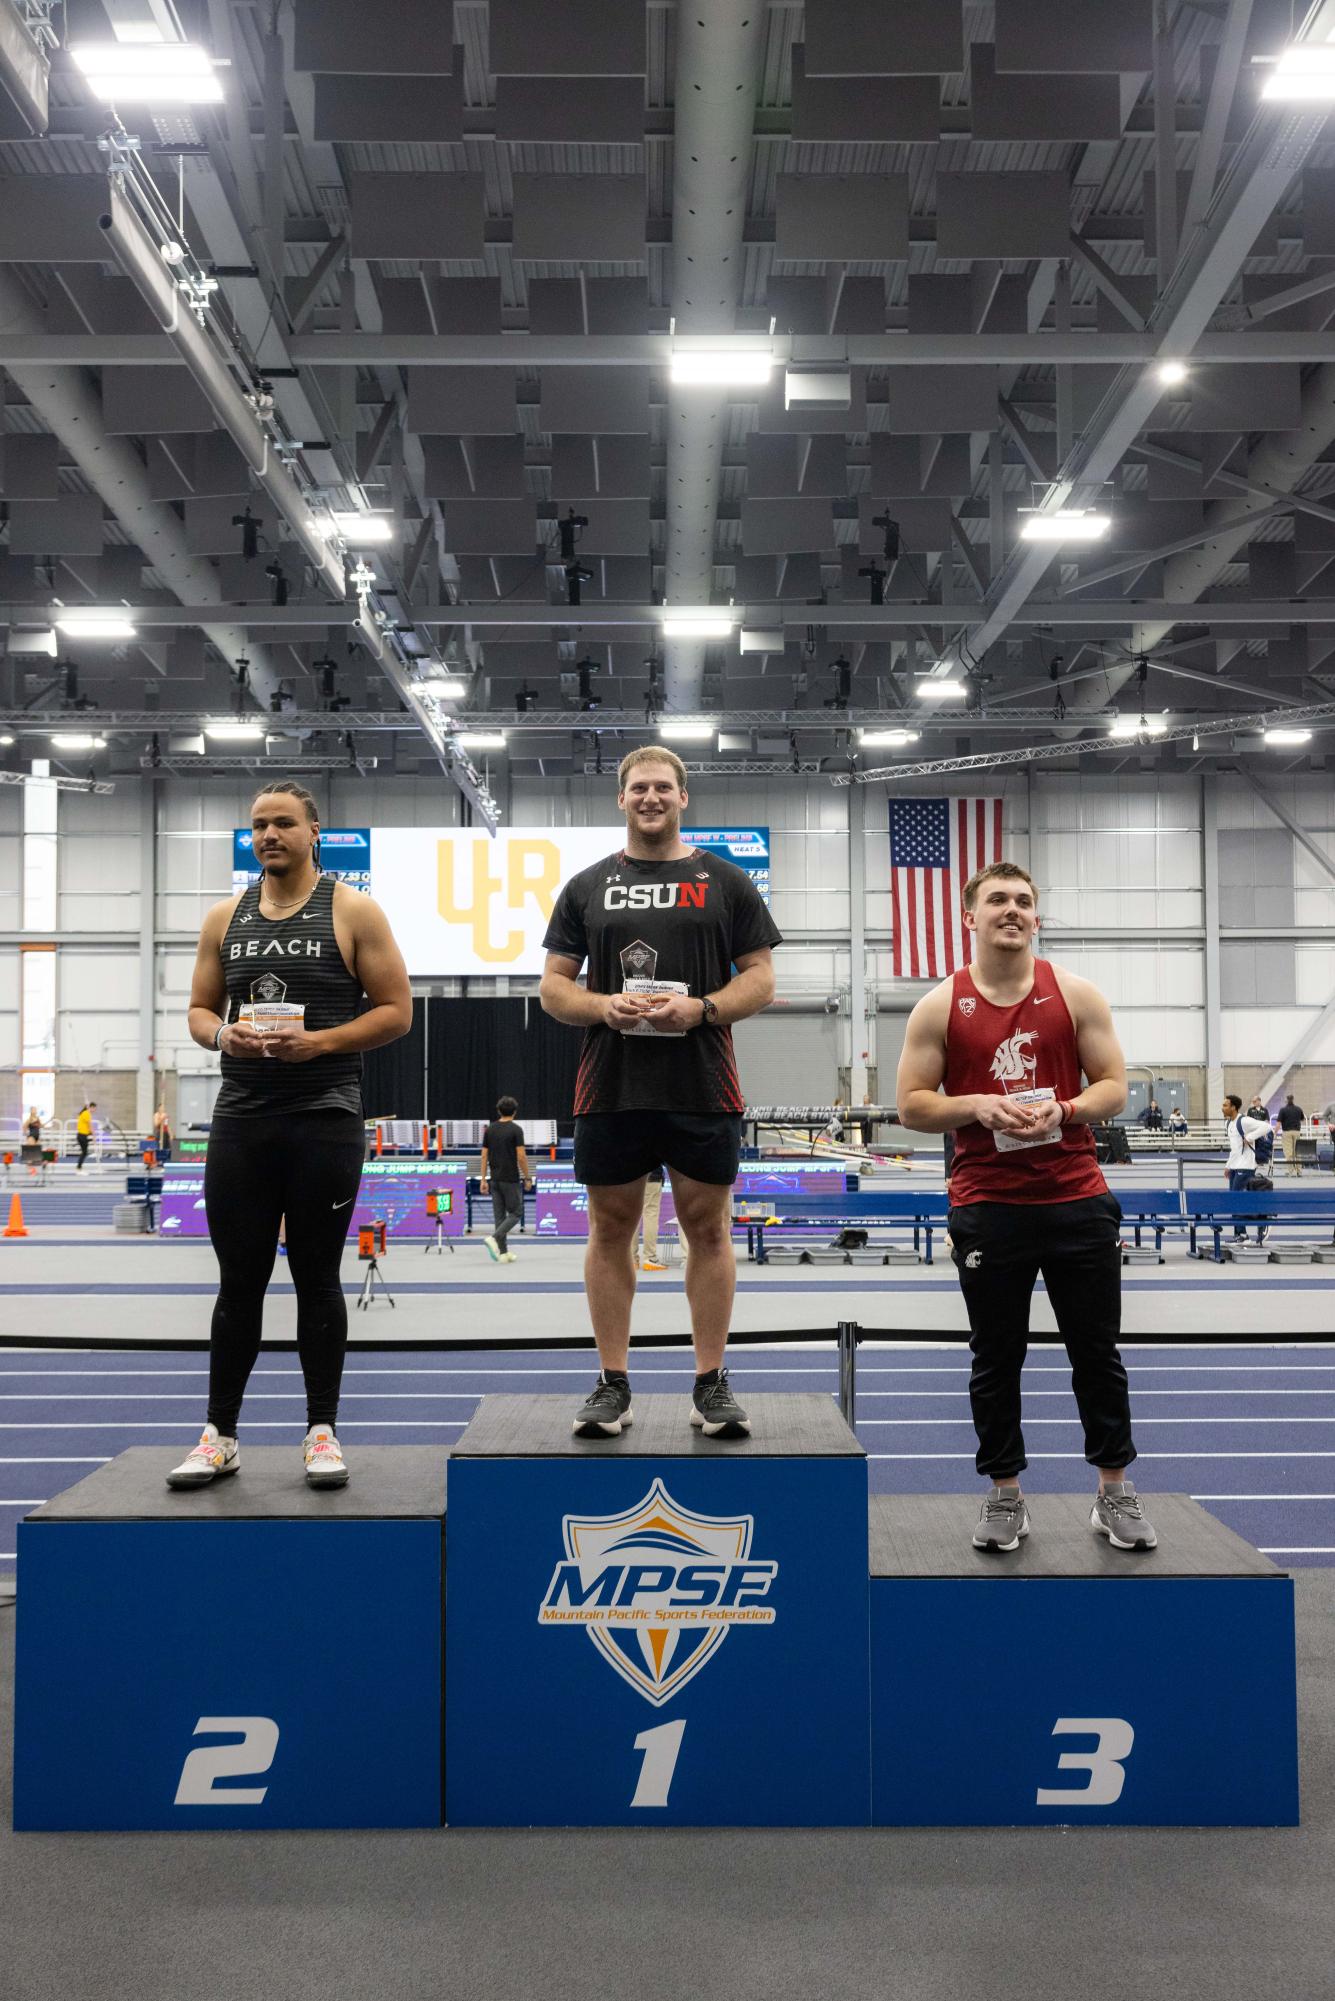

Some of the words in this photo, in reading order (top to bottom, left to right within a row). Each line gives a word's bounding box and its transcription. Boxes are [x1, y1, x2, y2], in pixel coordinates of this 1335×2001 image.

[604, 882, 708, 911] CSUN
[230, 940, 321, 960] BEACH
[386, 1164, 416, 1174] JUMP
[546, 1565, 773, 1606] MPSF
[542, 1609, 604, 1620] Mountain
[608, 1608, 651, 1620] Pacific
[654, 1609, 698, 1621] Sports
[701, 1608, 772, 1620] Federation
[174, 1716, 280, 1805] 2
[629, 1719, 687, 1807] 1
[1036, 1717, 1135, 1805] 3
